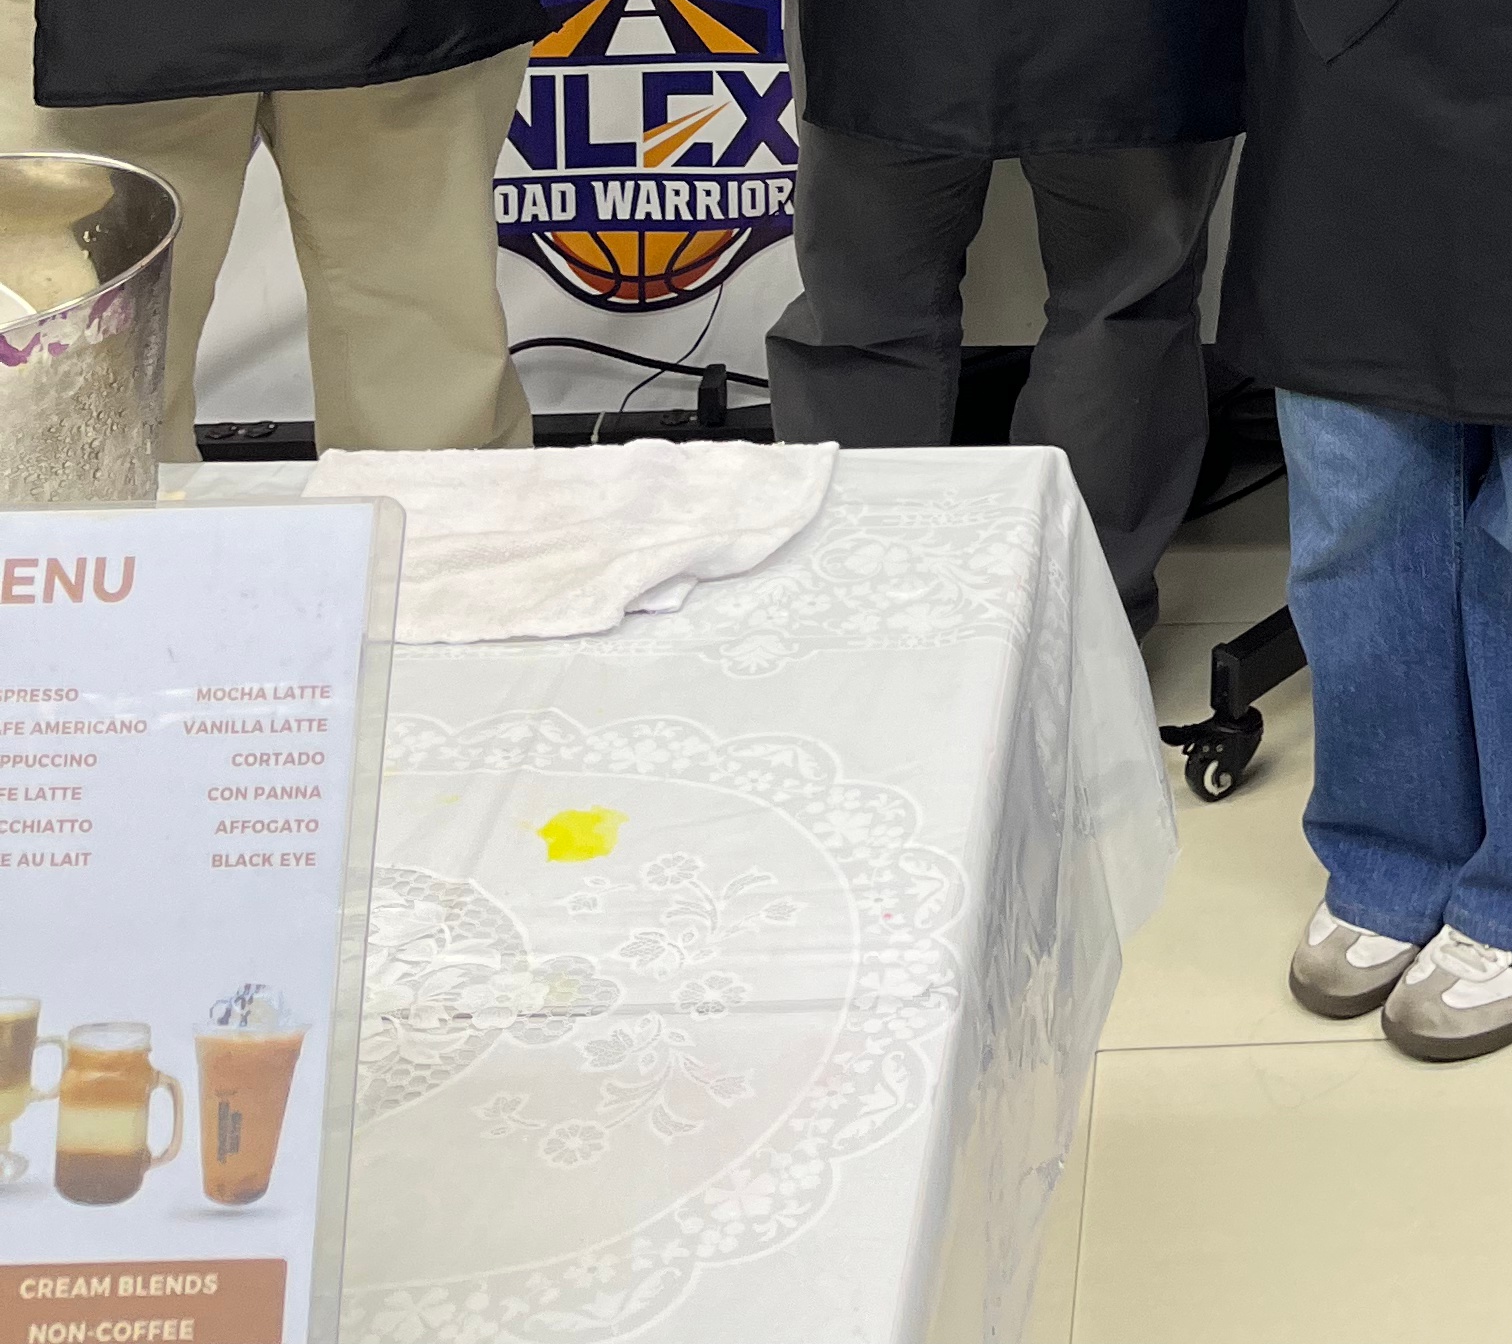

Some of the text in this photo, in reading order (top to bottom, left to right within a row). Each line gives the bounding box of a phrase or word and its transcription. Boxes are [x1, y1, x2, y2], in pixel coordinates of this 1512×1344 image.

[0, 555, 136, 605] ENU
[196, 685, 332, 703] MOCHA LATTE
[0, 719, 148, 736] FE AMERICANO
[183, 717, 329, 736] VANILLA LATTE
[231, 751, 326, 768] CORTADO
[24, 786, 83, 802] LATTE
[207, 784, 322, 802] CON PANNA
[214, 818, 320, 835] AFFOGATO
[17, 852, 46, 868] AU
[50, 851, 93, 867] LAIT
[210, 851, 317, 869] BLACK EYE
[19, 1271, 219, 1300] CREAM BLENDS
[28, 1317, 196, 1344] NON-COFFEE
